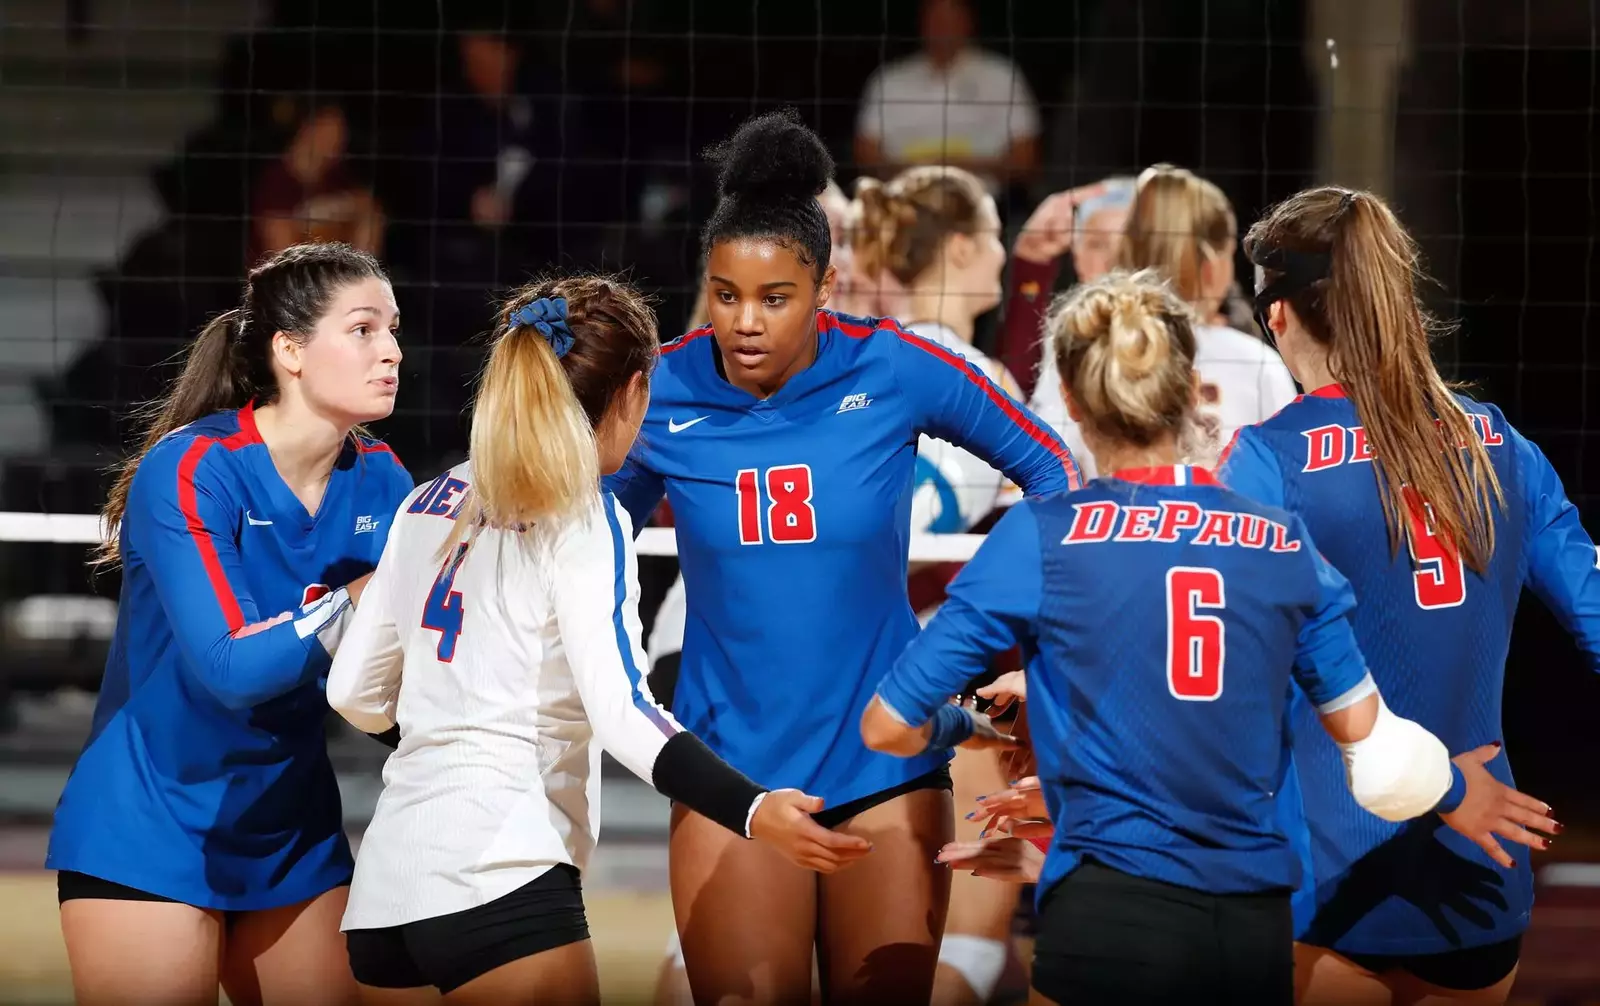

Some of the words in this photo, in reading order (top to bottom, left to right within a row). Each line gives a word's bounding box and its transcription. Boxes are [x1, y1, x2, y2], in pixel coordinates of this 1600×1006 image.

[838, 399, 874, 410] EAST
[842, 393, 868, 402] BIG
[355, 521, 380, 531] EAST
[356, 515, 372, 523] BIG
[736, 464, 817, 545] 18
[1401, 481, 1466, 610] 9
[421, 542, 468, 663] 4
[1166, 566, 1225, 701] 6
